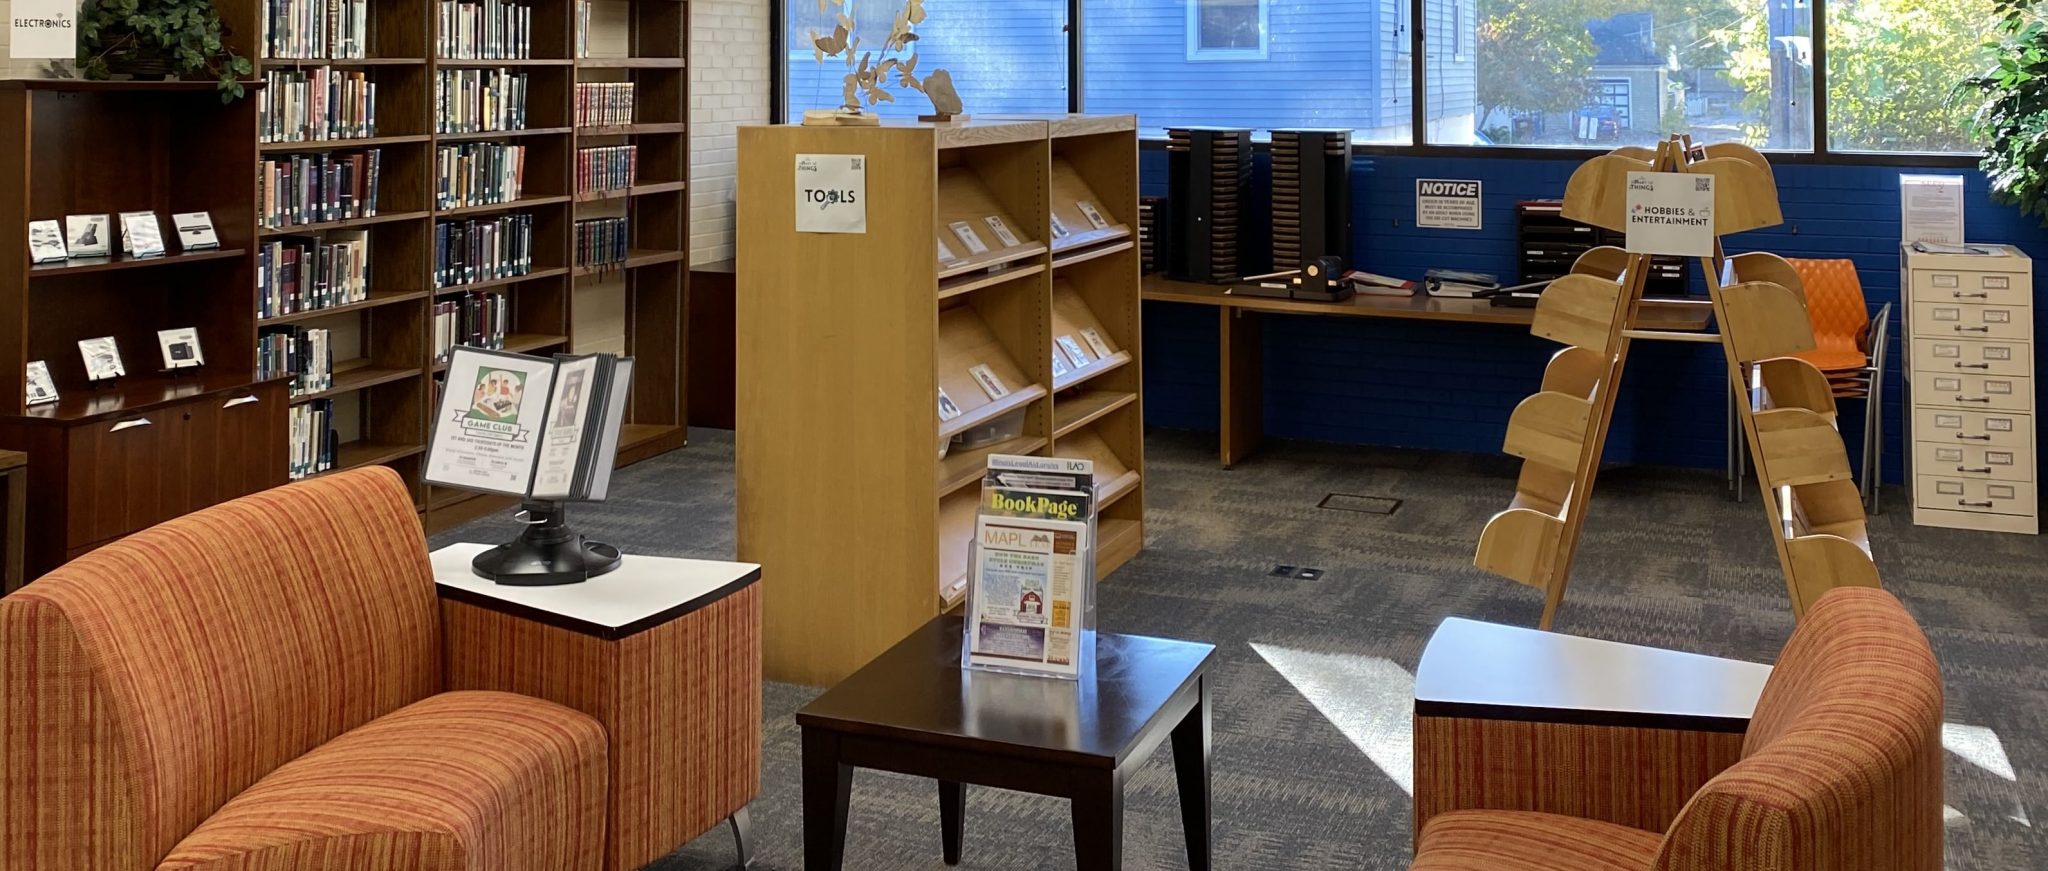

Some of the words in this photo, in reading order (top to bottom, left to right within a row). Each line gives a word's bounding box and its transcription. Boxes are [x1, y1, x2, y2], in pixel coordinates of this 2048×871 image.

[14, 18, 72, 28] ELECTRONICS
[1421, 182, 1477, 196] NOTICE
[804, 189, 856, 204] TOOLS
[1644, 206, 1685, 216] HOBBIES
[1688, 208, 1696, 216] &
[1632, 215, 1709, 226] ENTERTAINMENT
[467, 420, 492, 430] GAME
[492, 422, 513, 432] CLUB
[991, 492, 1078, 519] BookPage
